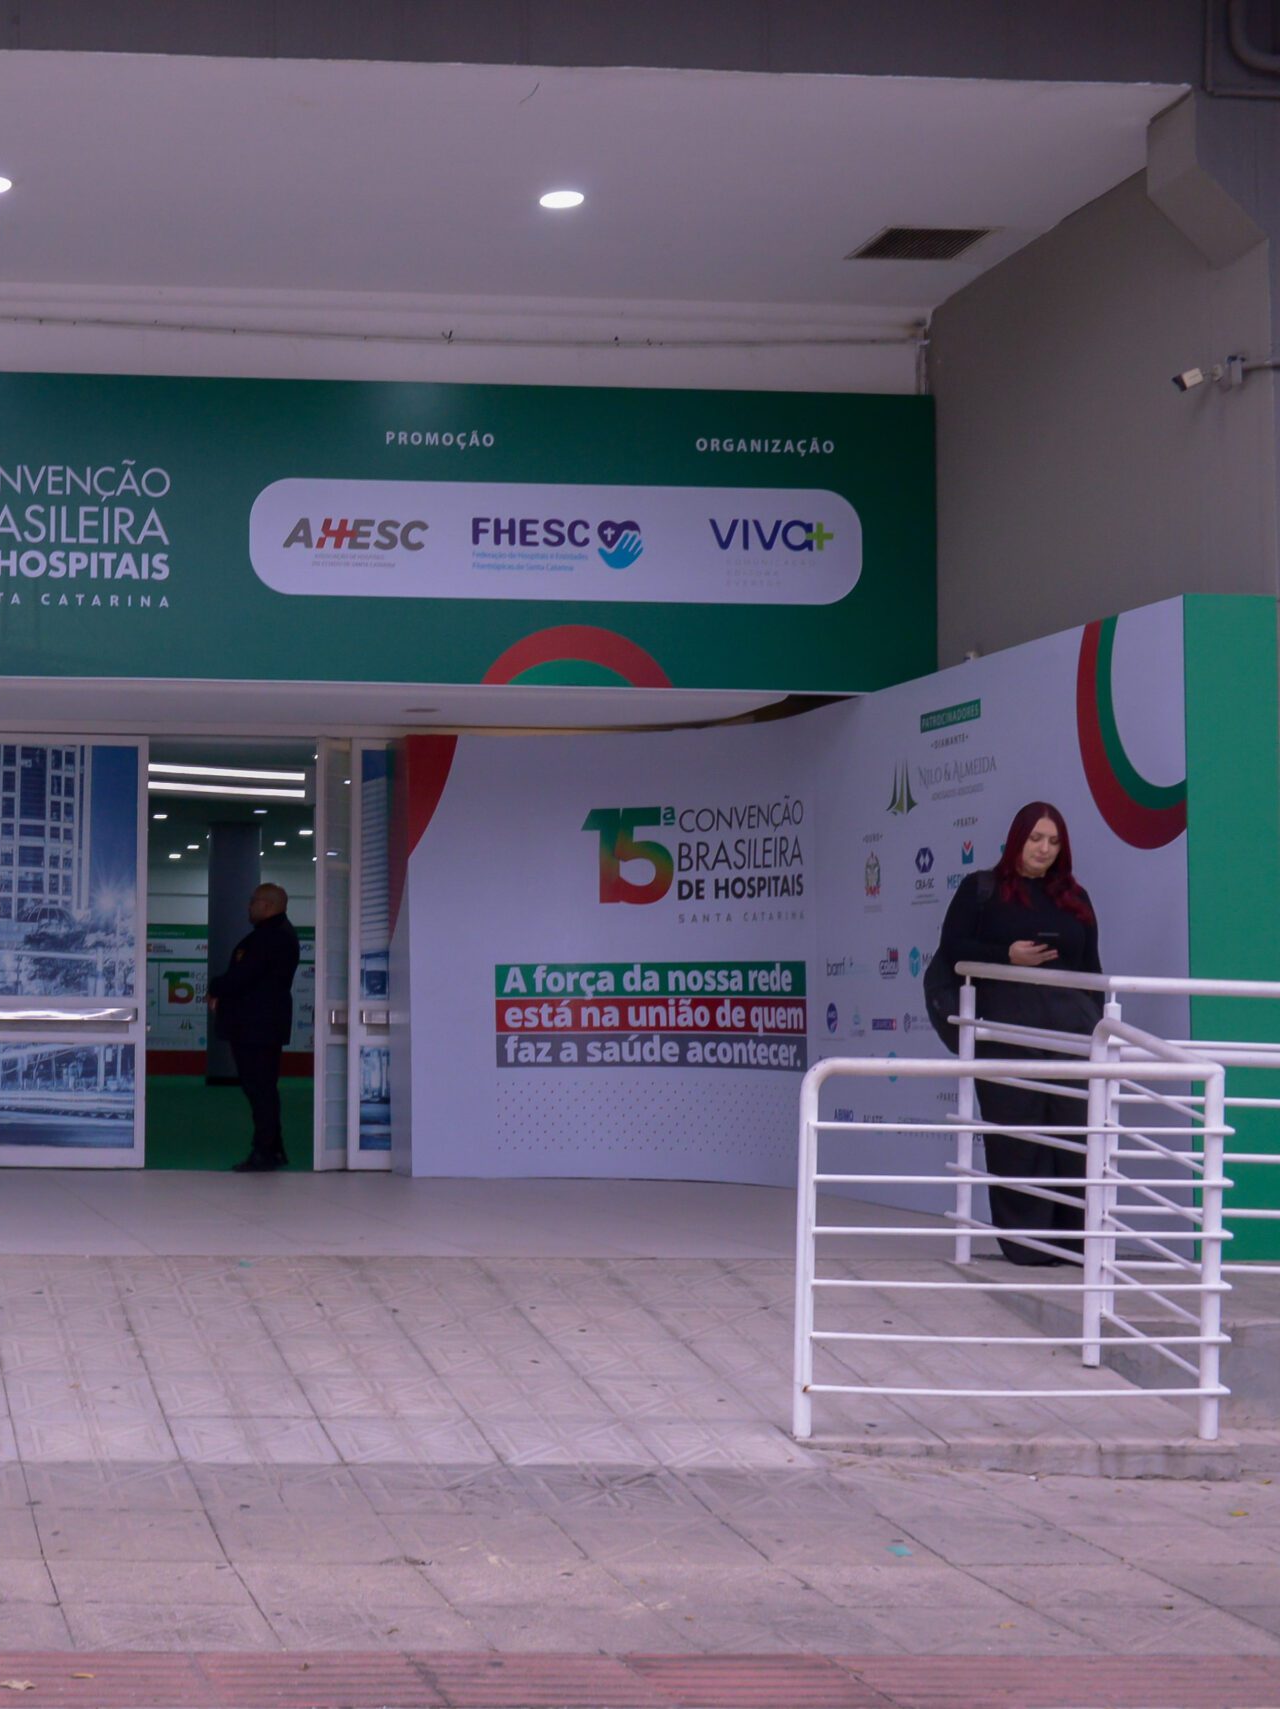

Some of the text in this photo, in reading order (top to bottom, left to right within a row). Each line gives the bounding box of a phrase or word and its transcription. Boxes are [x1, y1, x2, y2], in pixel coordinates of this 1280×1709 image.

[385, 430, 495, 451] PROMOÇÃO
[695, 437, 835, 458] ORGANIZAÇÃO
[282, 517, 429, 551] AHESC
[472, 517, 591, 548] FHESC
[40, 592, 170, 609] CATARINA
[679, 795, 804, 834] CONVENÇÃO
[677, 835, 803, 872] BRASILEIRA
[677, 874, 804, 901] DE HOSPITAIS
[678, 911, 805, 924] SANTA CATARINA
[503, 963, 793, 1000] A força da nossa rede
[504, 998, 804, 1037] está na união de quem
[504, 1034, 801, 1068] faz a saúde acontecer.
